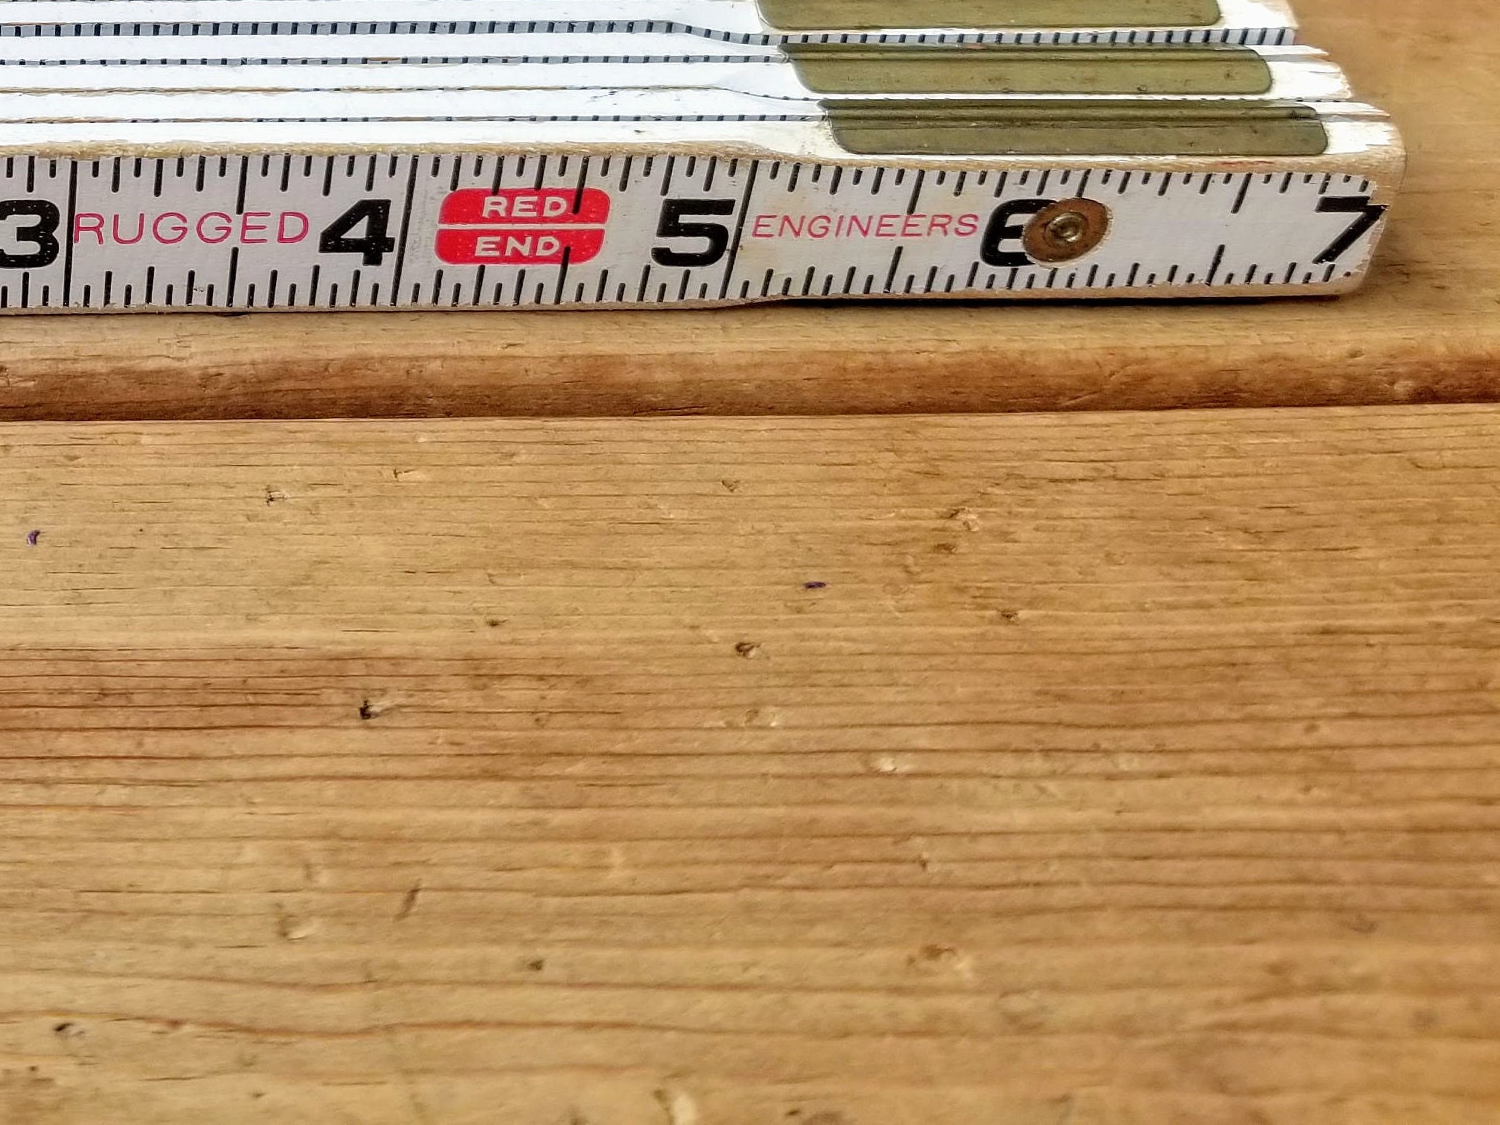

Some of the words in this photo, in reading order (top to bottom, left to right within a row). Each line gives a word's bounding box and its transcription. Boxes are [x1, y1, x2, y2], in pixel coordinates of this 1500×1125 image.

[481, 194, 567, 218] RED
[73, 211, 309, 245] RUGGED
[318, 198, 396, 266] 4
[650, 198, 736, 267] 5
[751, 213, 979, 239] ENGINEERS
[1312, 195, 1388, 265] 7
[473, 234, 561, 257] END
